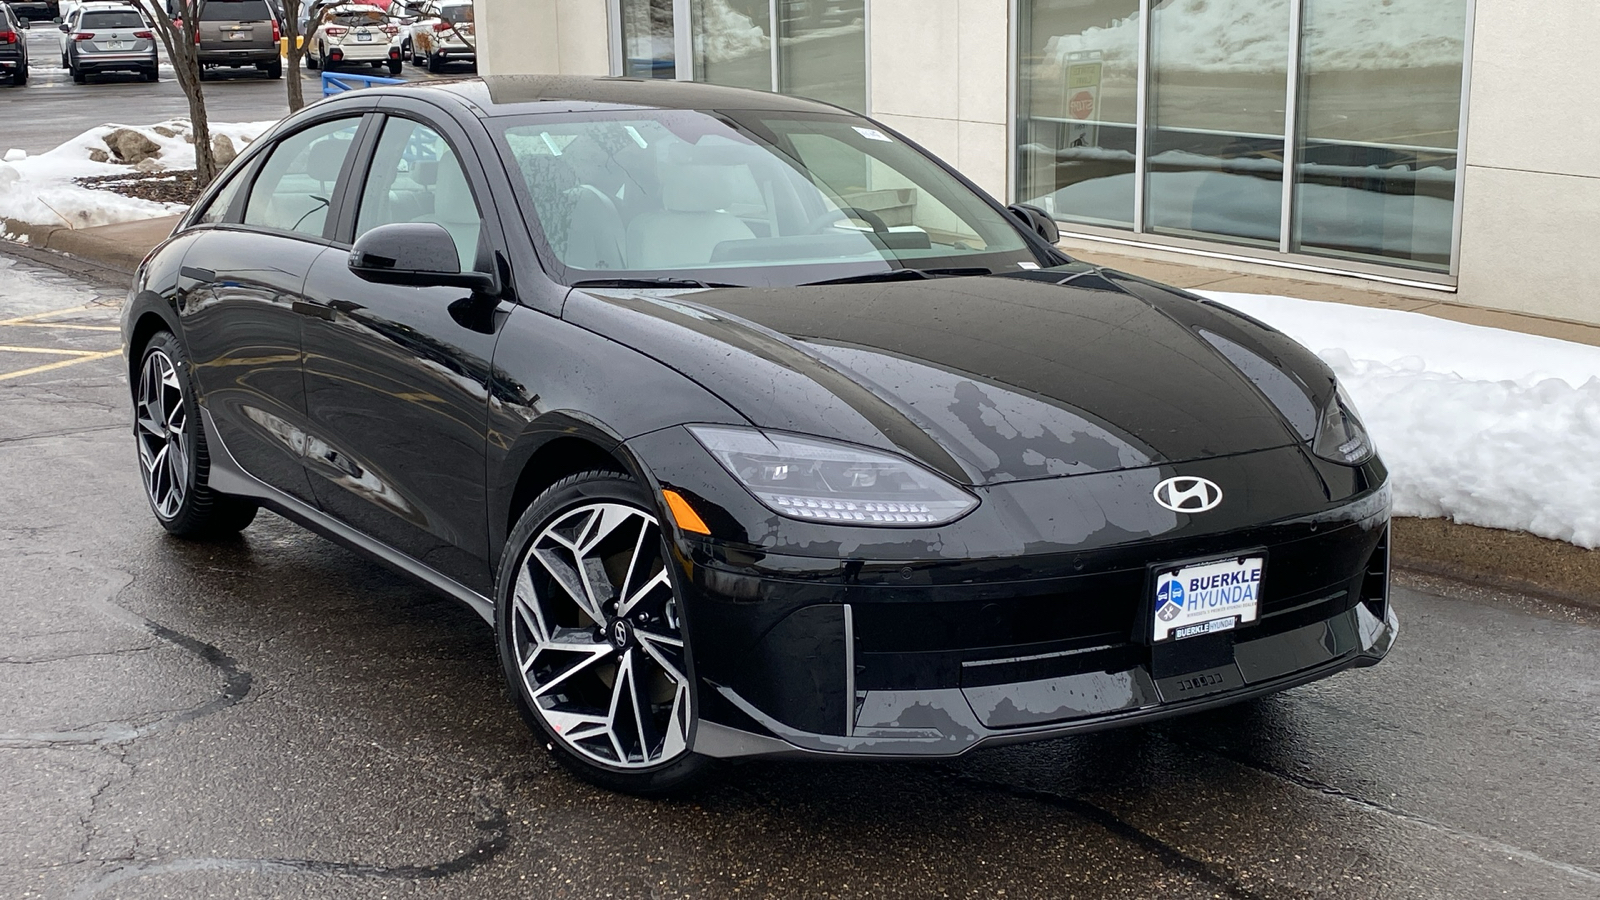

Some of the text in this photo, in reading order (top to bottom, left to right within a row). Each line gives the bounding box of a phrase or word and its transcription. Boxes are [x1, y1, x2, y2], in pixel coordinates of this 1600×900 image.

[1190, 568, 1260, 592] BUERKLE
[1187, 583, 1259, 611] HYUNDAI
[1176, 619, 1233, 638] BUERKLE HYUNDAI
